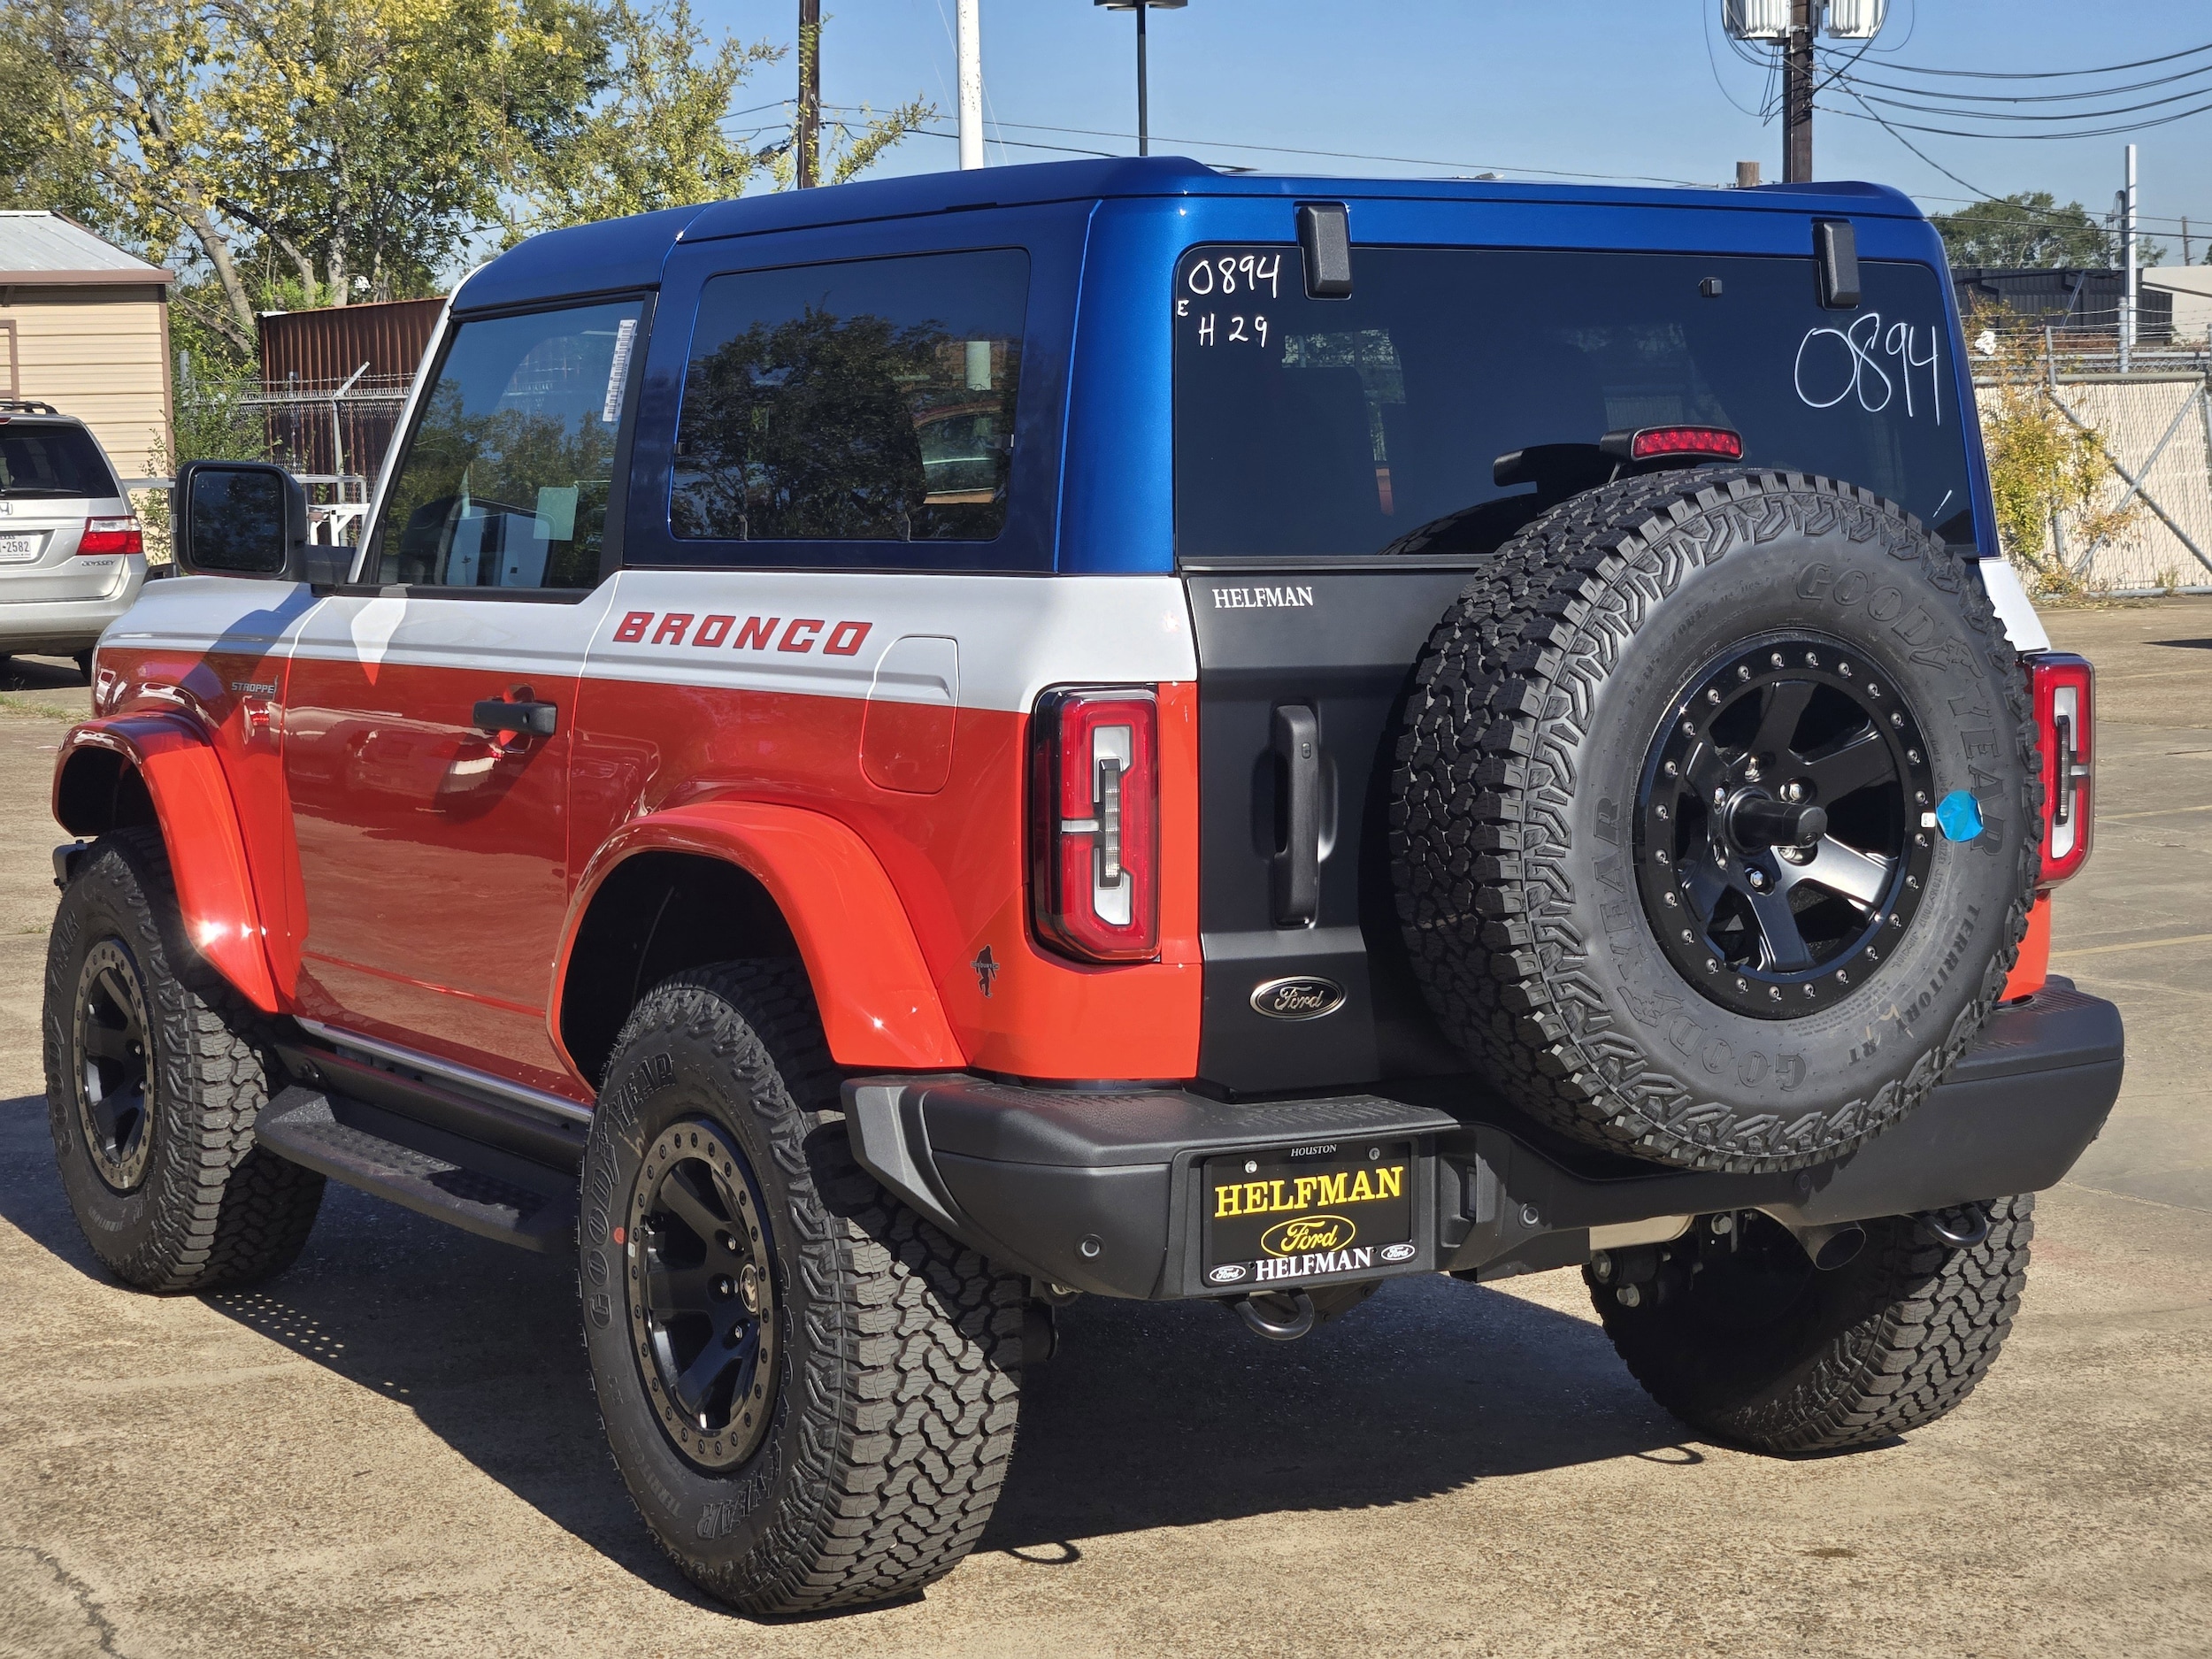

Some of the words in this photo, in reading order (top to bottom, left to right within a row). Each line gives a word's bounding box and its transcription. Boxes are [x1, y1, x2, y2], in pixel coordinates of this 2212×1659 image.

[1188, 254, 1280, 299] 0894
[1177, 299, 1190, 317] E
[1794, 312, 1940, 426] 0894
[1211, 587, 1314, 609] HELFMAN
[612, 611, 873, 657] BRONCO
[231, 681, 275, 695] STROPPE
[1274, 986, 1325, 1010] Ford
[1290, 1144, 1338, 1157] HOUSTON
[1214, 1165, 1404, 1217] HELFMAN
[1280, 1220, 1339, 1252] Ford
[1255, 1246, 1374, 1282] HELFMAN
